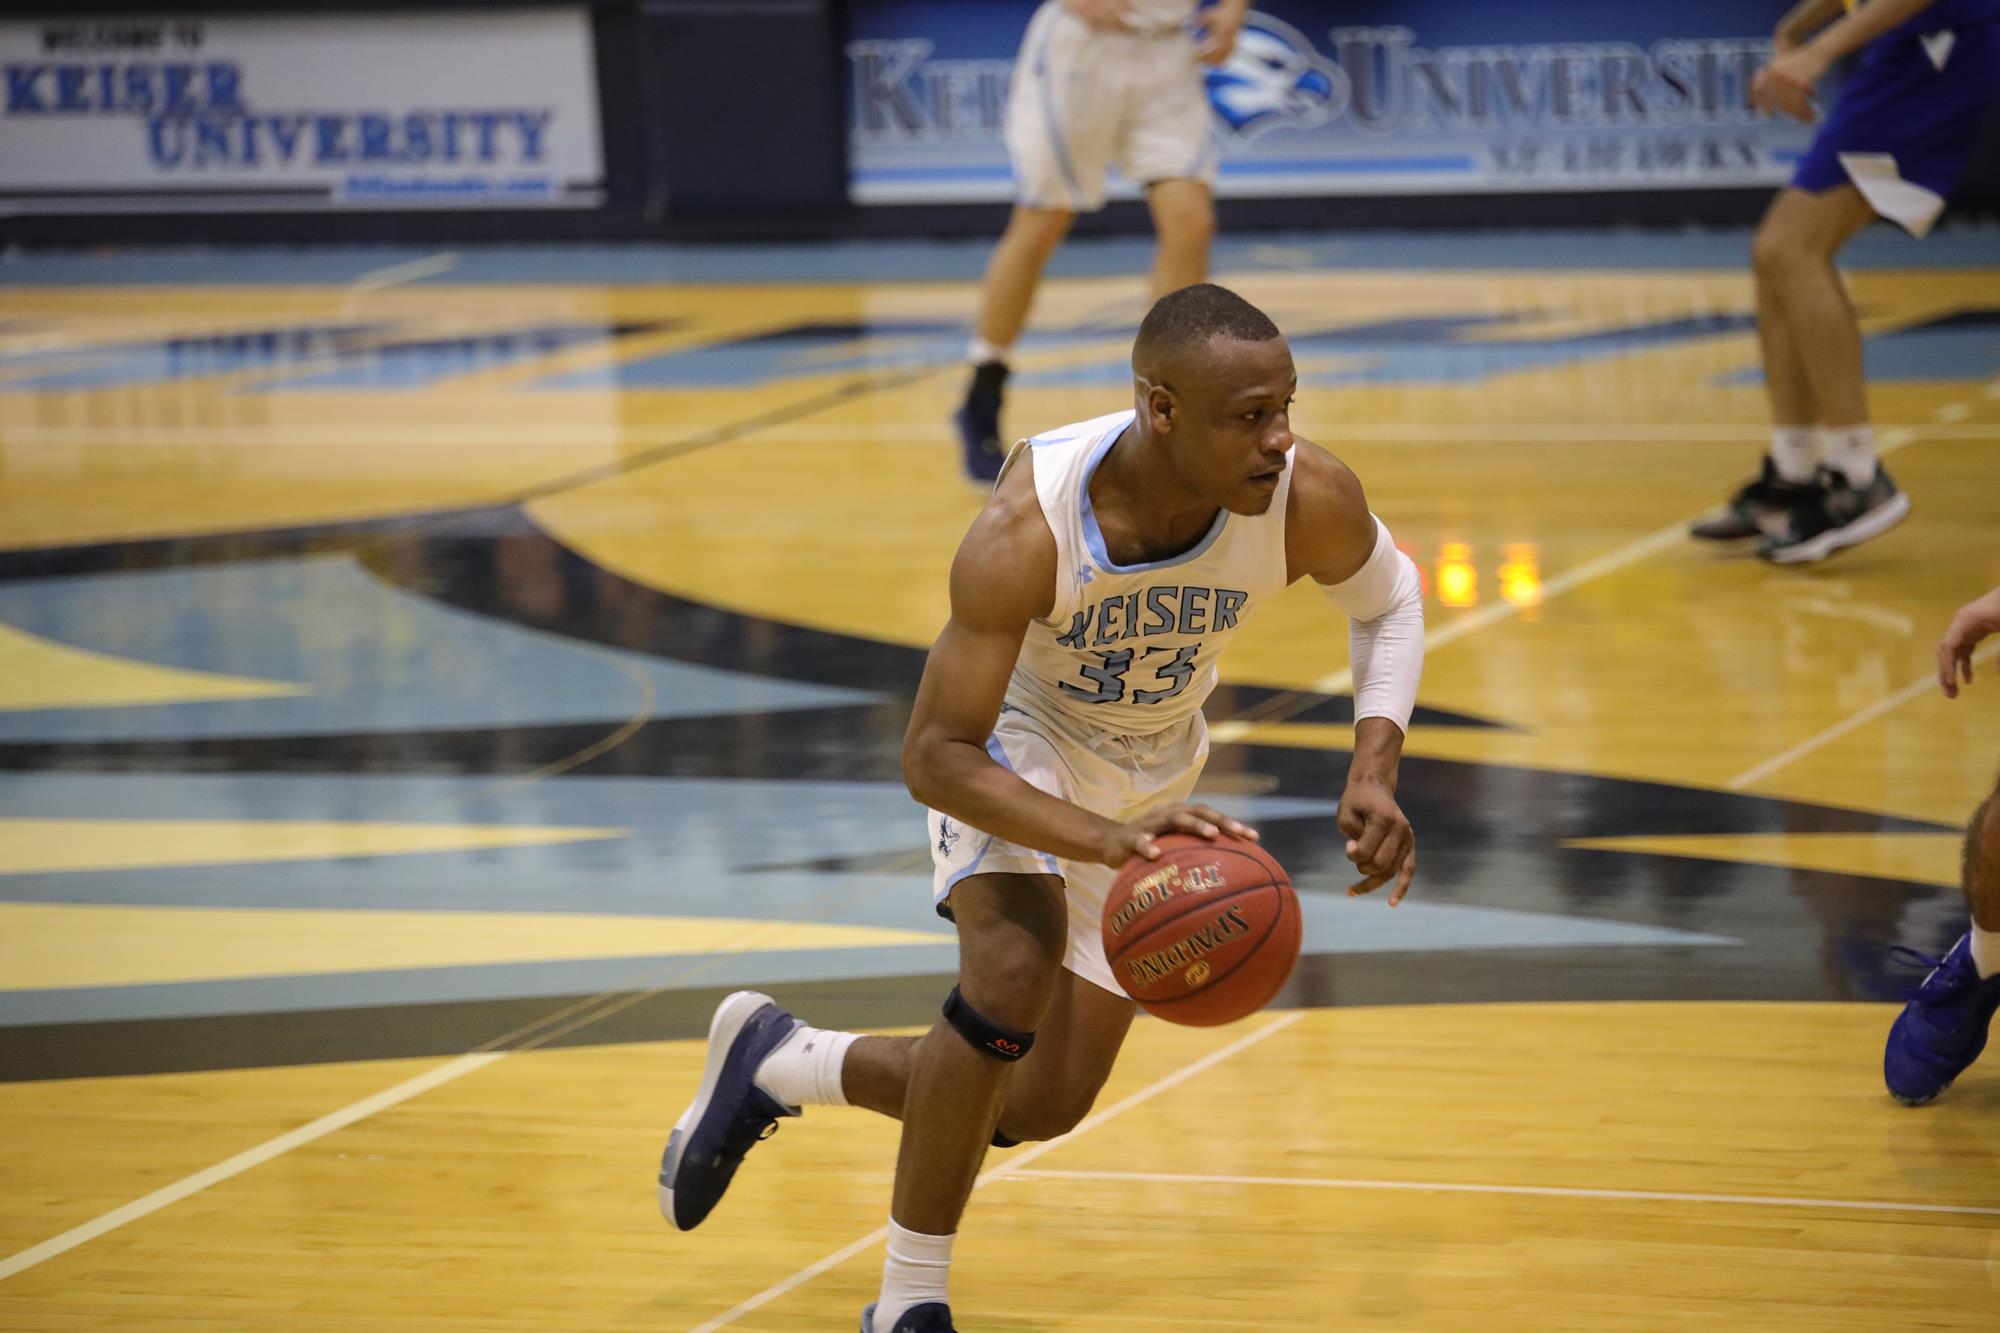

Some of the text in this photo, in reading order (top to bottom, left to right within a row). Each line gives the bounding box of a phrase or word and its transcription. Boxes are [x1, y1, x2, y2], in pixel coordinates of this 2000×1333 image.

[4, 62, 248, 116] KEISER
[846, 26, 1778, 140] KEI UNIVERSIT
[147, 109, 553, 168] UNIVERSITY
[1056, 586, 1248, 650] KEISER
[1058, 643, 1202, 704] 33
[1127, 904, 1250, 987] SPALDING
